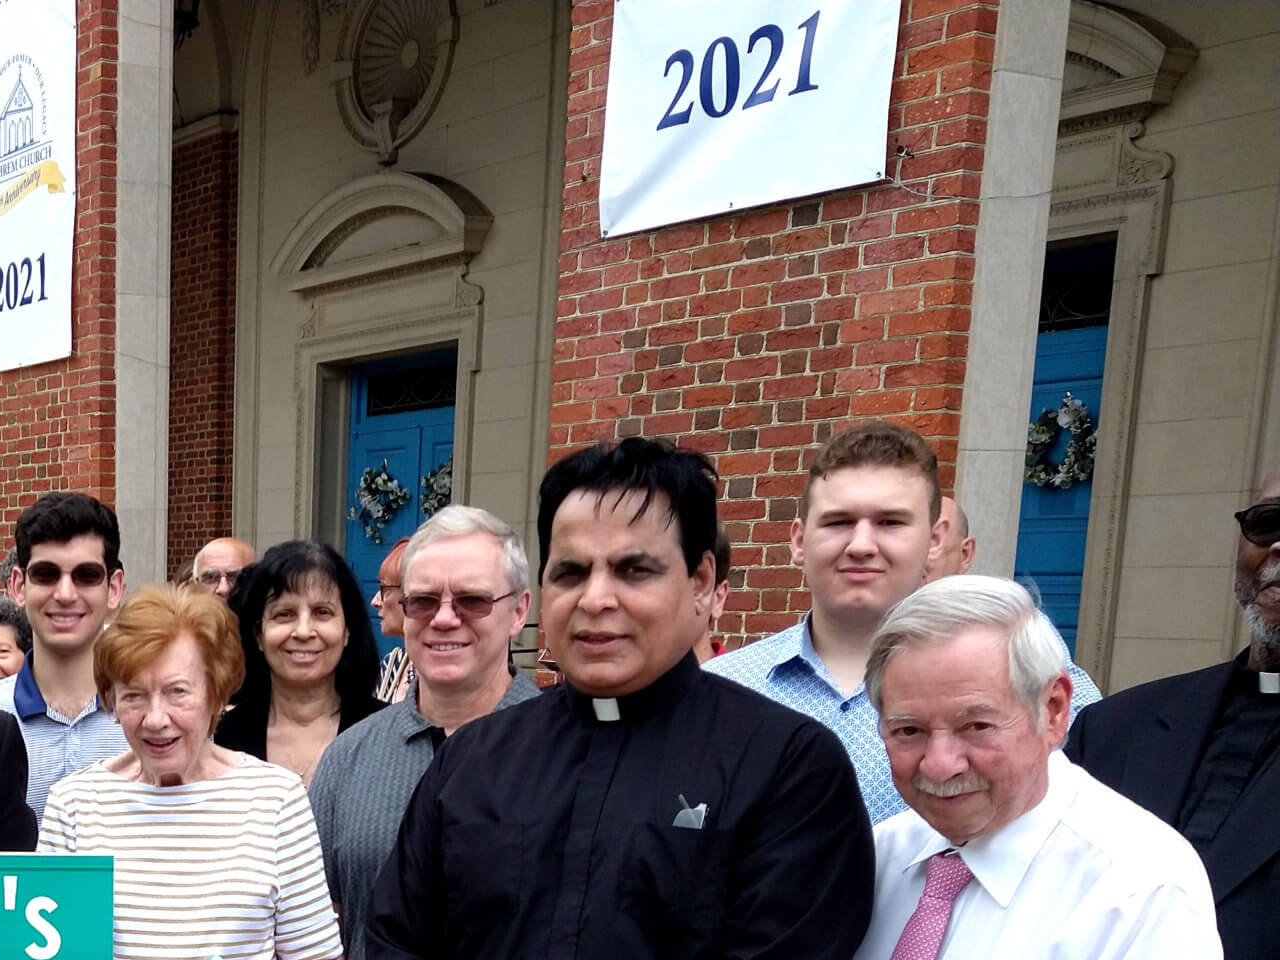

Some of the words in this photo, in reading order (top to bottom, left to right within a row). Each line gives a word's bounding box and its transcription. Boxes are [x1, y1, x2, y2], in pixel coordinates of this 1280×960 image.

[656, 10, 821, 131] 2021
[19, 145, 52, 169] CHURCH
[4, 168, 41, 208] Anniversary
